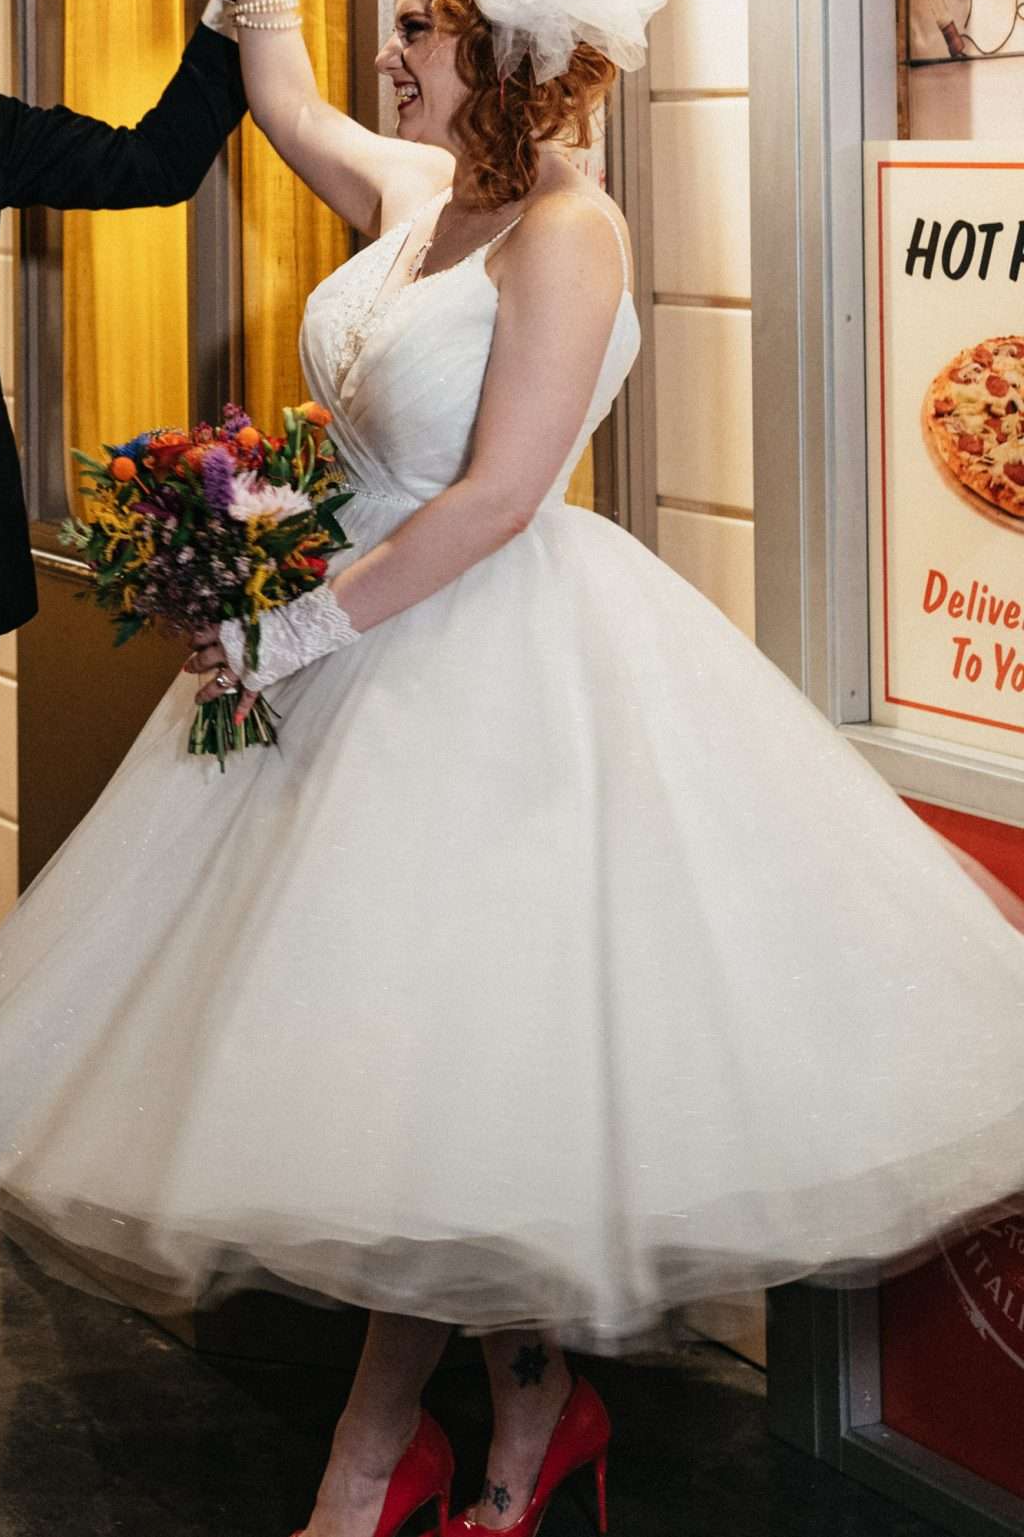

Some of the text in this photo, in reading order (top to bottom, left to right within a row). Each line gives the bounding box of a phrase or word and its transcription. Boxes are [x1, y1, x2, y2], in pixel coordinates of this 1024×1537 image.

[905, 217, 1004, 281] HOT
[923, 569, 1024, 630] Delive
[952, 637, 982, 683] To
